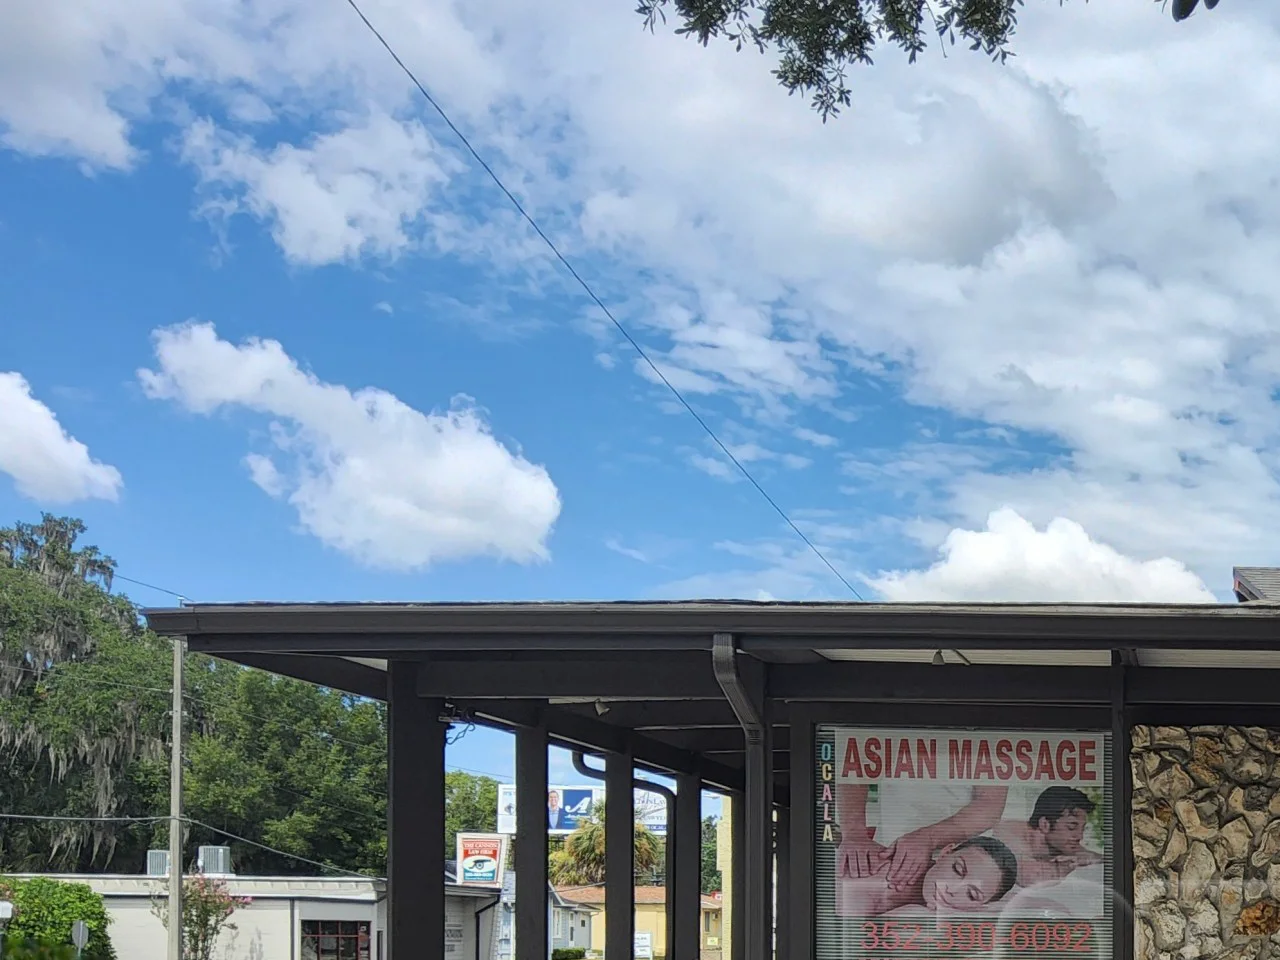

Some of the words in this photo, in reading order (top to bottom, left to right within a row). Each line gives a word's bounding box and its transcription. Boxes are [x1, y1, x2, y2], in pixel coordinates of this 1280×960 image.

[841, 737, 937, 780] ASIAN
[949, 738, 1097, 782] MASSAGE
[820, 742, 834, 842] OCALA
[859, 921, 1093, 952] 352-390-6092
